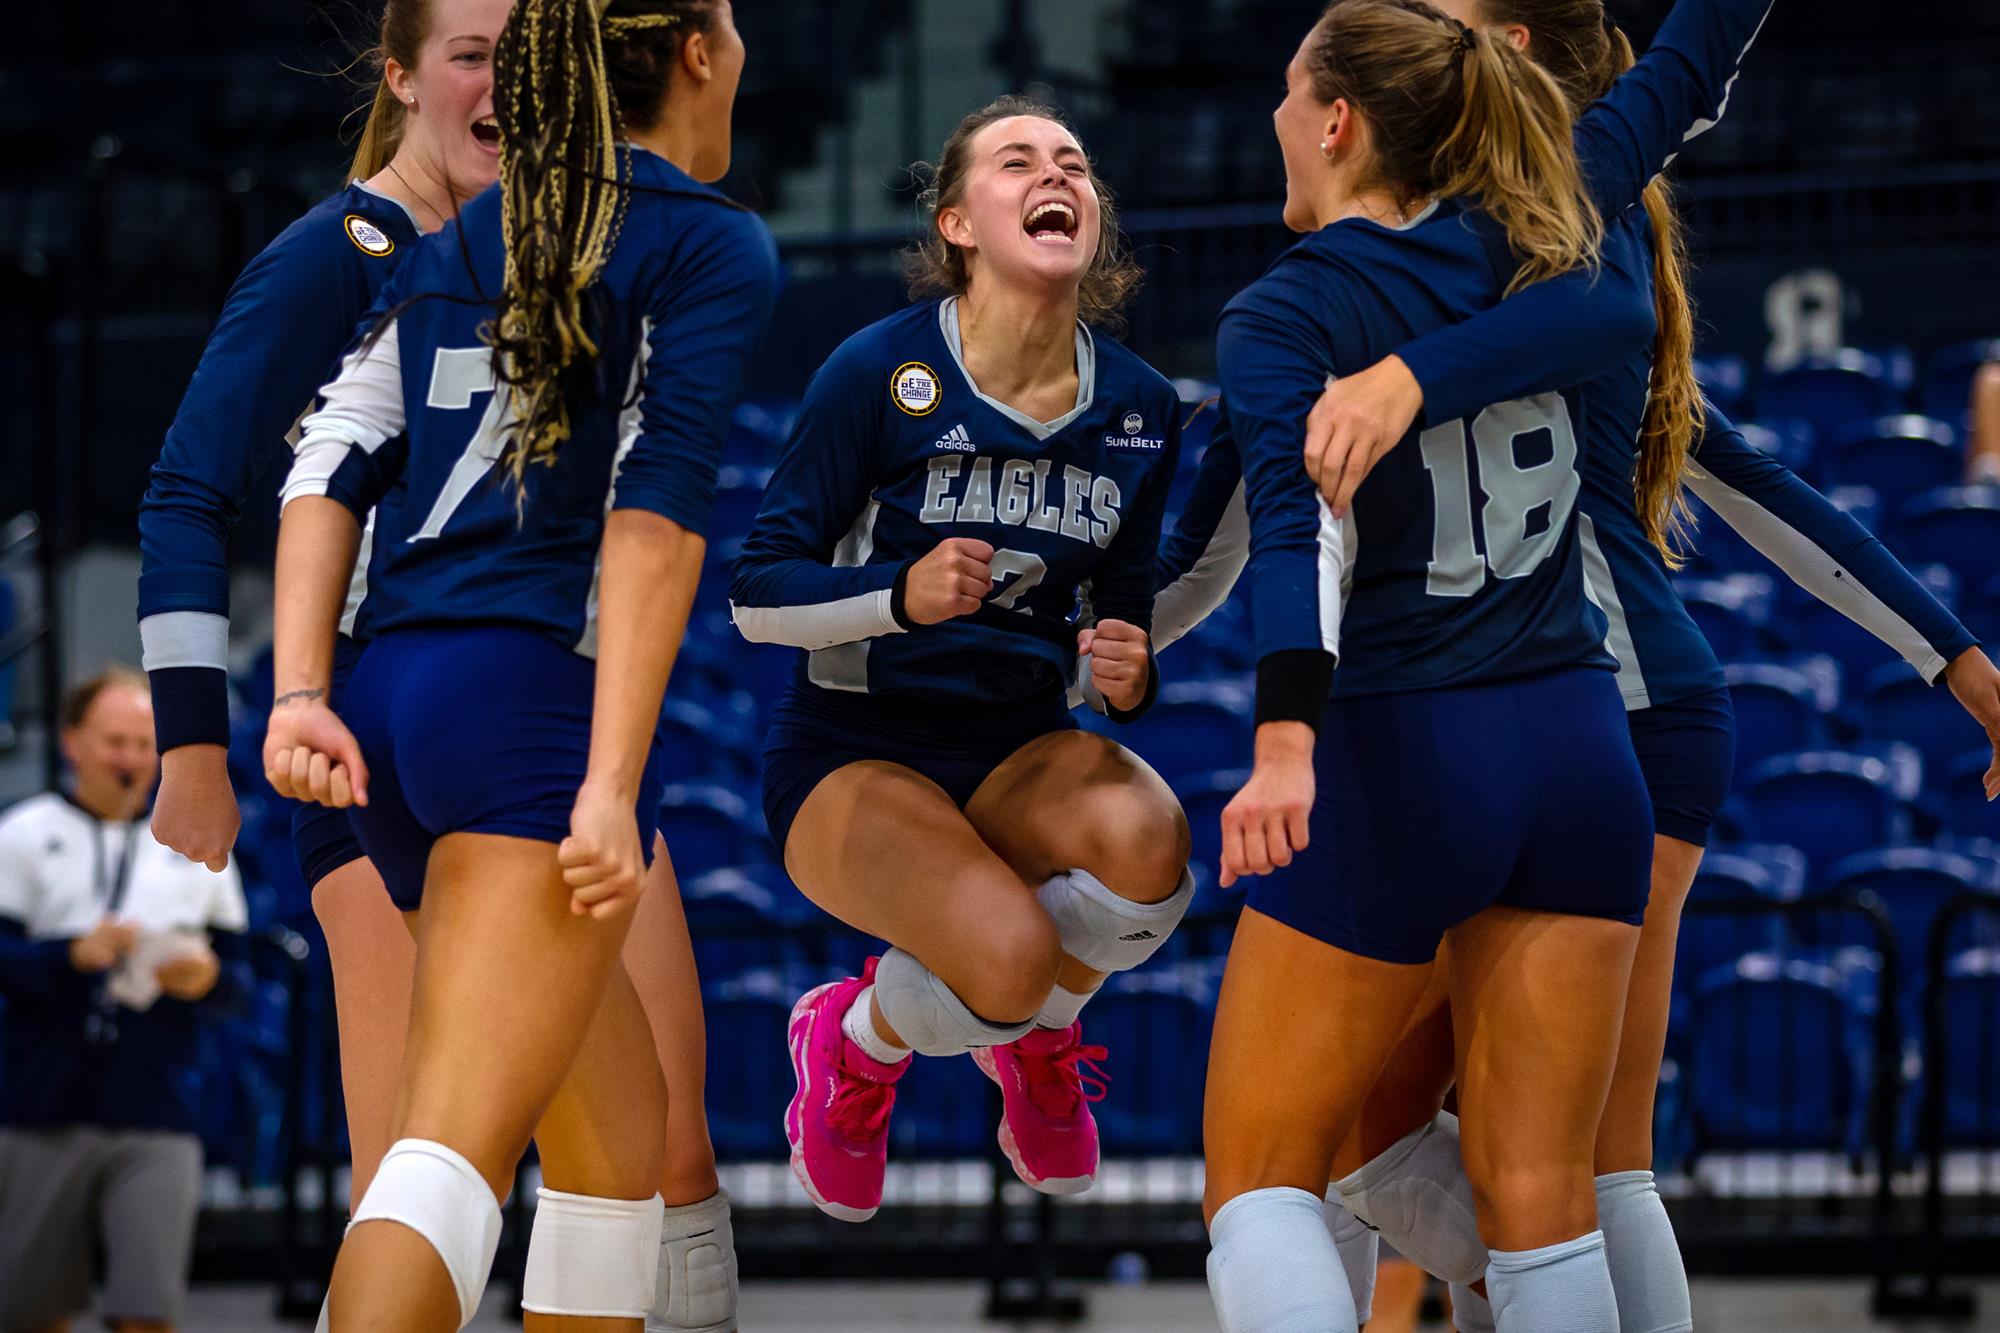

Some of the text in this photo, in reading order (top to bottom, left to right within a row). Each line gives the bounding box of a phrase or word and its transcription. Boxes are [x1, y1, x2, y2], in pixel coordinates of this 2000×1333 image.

[901, 377, 931, 389] BE THE
[901, 388, 932, 399] CHANGE
[406, 347, 524, 543] 7
[935, 439, 976, 452] adidas
[1105, 436, 1164, 449] SUN BELT
[1419, 390, 1581, 597] 18
[920, 454, 1121, 550] EAGLES
